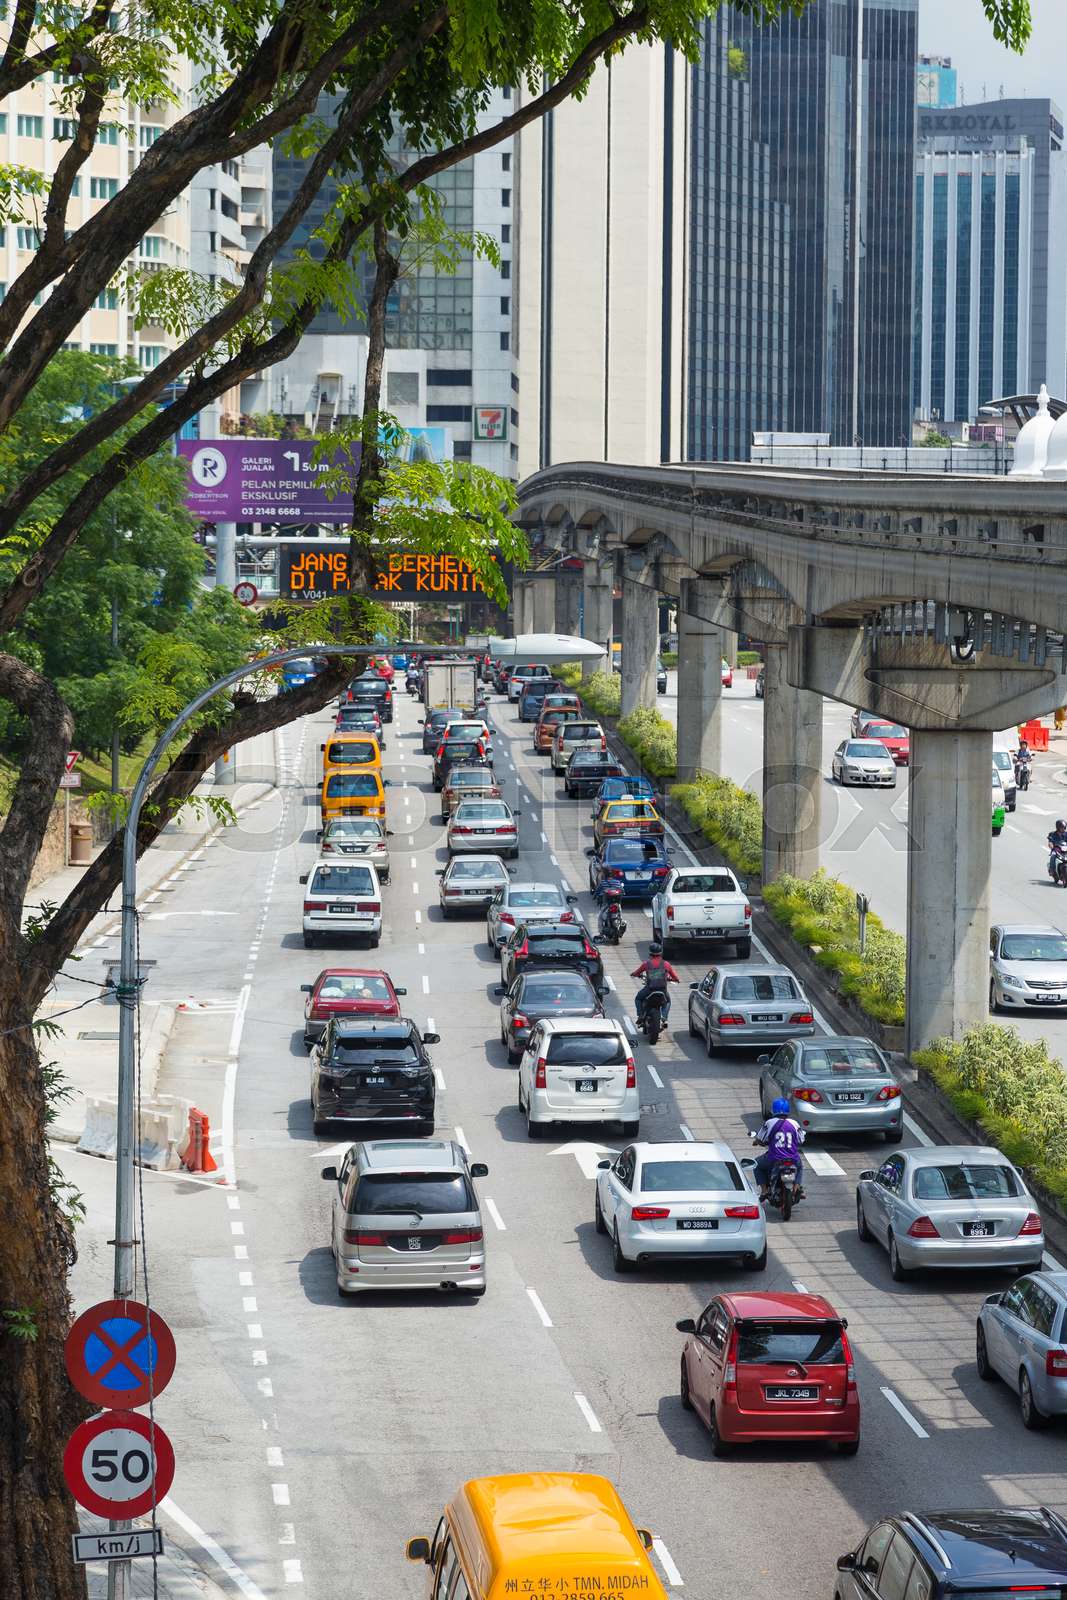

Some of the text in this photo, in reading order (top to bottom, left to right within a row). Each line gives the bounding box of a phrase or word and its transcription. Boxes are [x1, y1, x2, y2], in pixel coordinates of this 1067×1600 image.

[920, 115, 1016, 131] RKROYAL
[241, 480, 277, 489] PELAN
[241, 491, 298, 500] EKSKLUSIF
[241, 507, 254, 516] 03
[255, 507, 276, 516] 2148
[278, 507, 301, 516] 6668
[291, 552, 348, 572] JANG
[290, 571, 316, 590] DI
[303, 590, 328, 599] V041
[774, 1131, 793, 1148] 21
[90, 1449, 150, 1483] 50
[97, 1535, 141, 1555] km/j
[573, 1576, 605, 1591] TMN.
[607, 1575, 649, 1589] MIDAH
